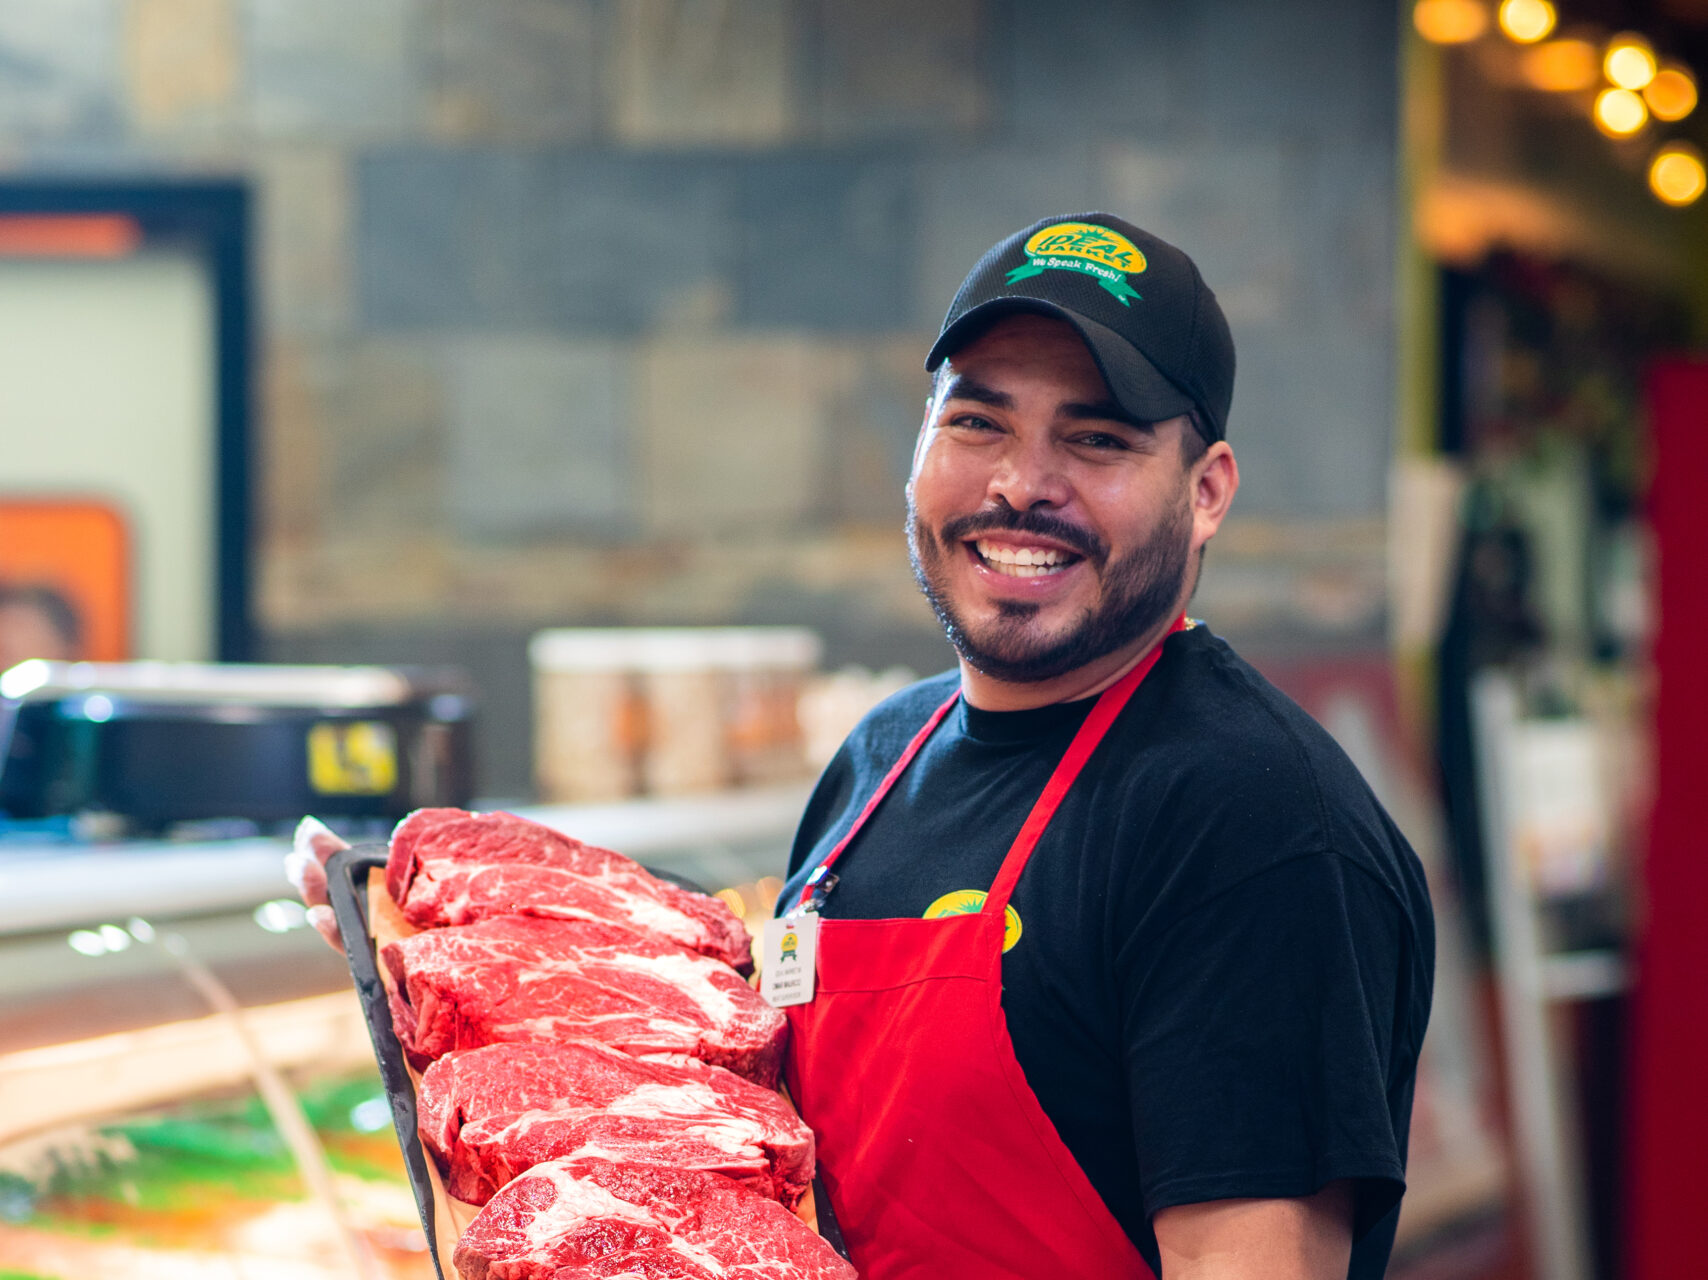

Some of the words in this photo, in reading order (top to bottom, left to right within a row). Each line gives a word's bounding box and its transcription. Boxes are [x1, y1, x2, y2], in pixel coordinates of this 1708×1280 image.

[1039, 234, 1133, 263] IDEAL
[1047, 257, 1082, 268] Speak
[1085, 262, 1122, 282] Fresh!
